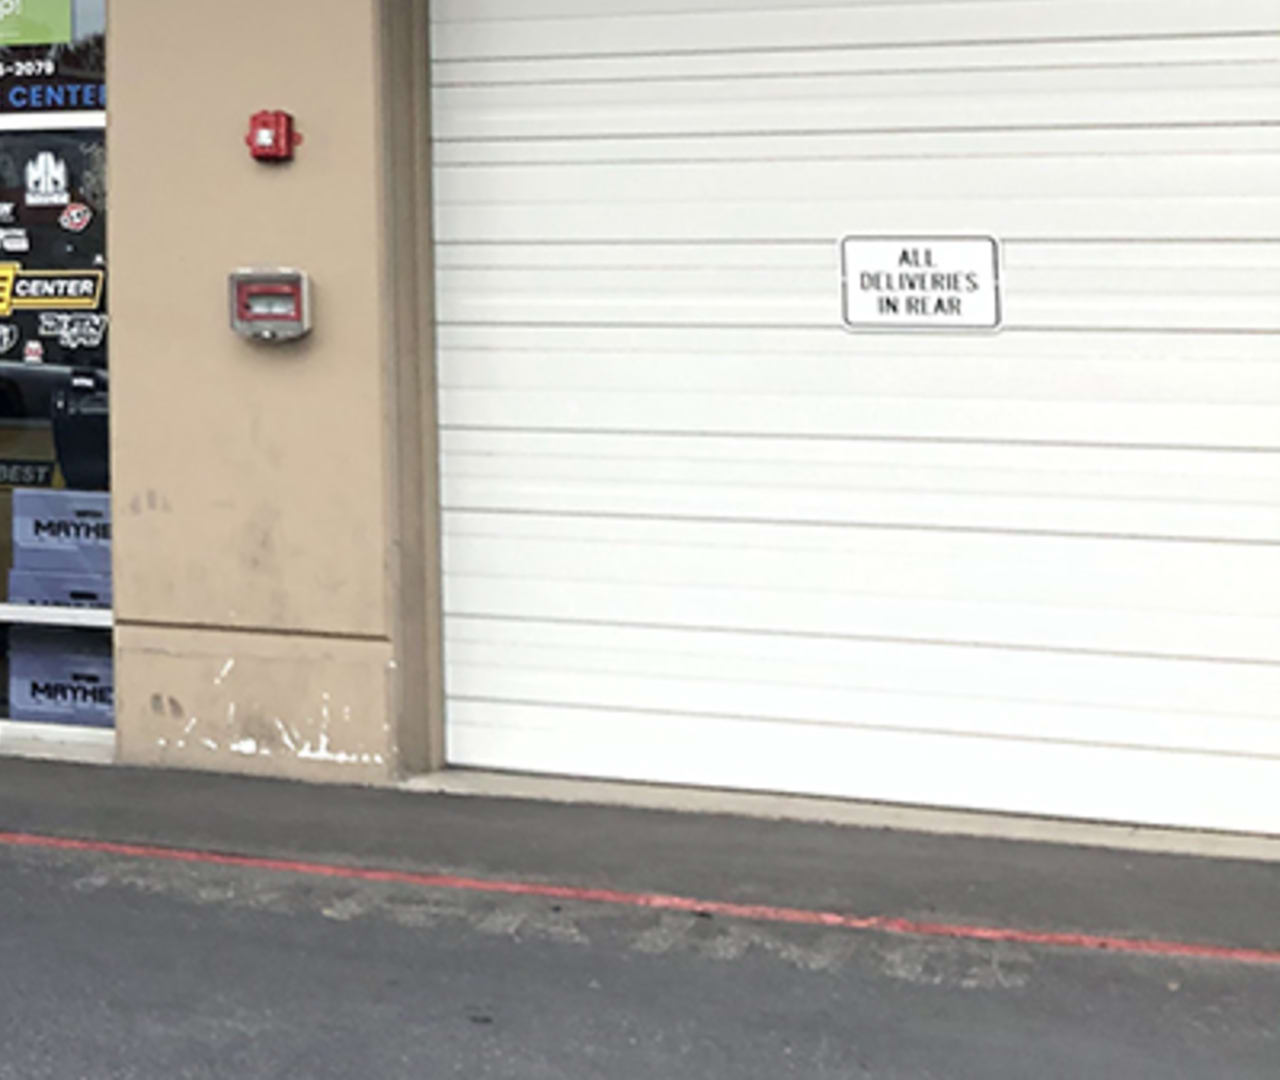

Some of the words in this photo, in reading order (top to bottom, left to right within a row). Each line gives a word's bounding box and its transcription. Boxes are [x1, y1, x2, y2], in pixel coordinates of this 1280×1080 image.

[898, 248, 937, 267] ALL
[15, 279, 94, 296] CENTER
[859, 271, 979, 293] DELIVERIES
[877, 296, 899, 315] IN
[905, 296, 962, 316] REAR
